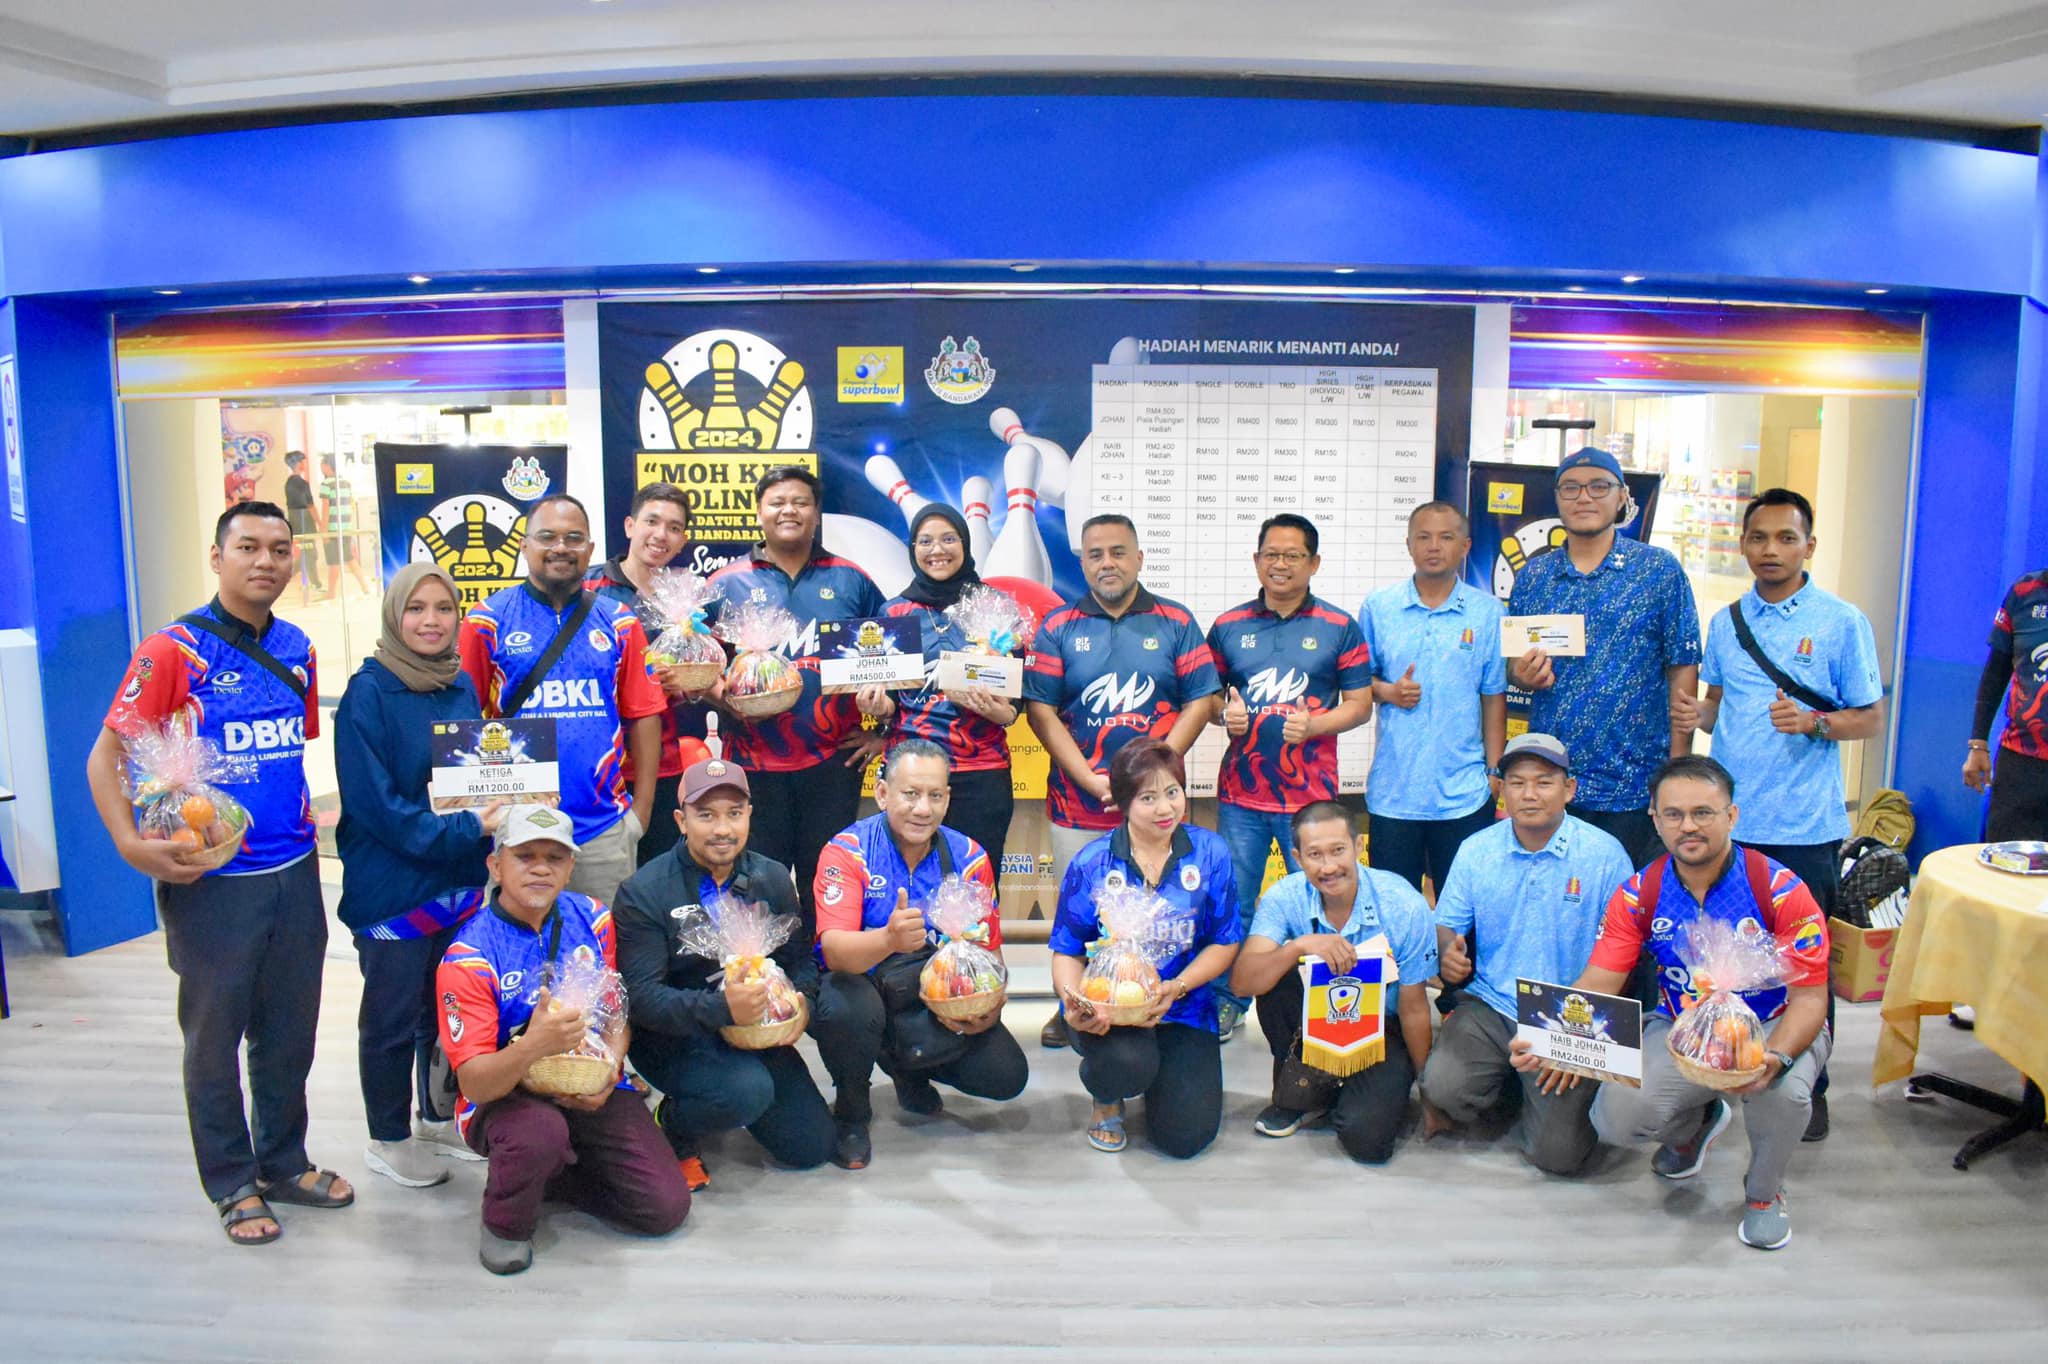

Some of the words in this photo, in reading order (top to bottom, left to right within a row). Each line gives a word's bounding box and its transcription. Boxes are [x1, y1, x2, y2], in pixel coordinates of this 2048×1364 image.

[1139, 339, 1200, 354] HADIAH
[1204, 340, 1274, 354] MENARIK
[1277, 341, 1346, 355] MENANTI
[1349, 343, 1399, 356] ANDA!
[1143, 380, 1179, 388] PASUKAN
[1234, 381, 1264, 389] DOUBLE
[842, 384, 900, 397] superbowl
[1100, 416, 1126, 424] JOHAN
[1196, 417, 1220, 425] RM200
[694, 429, 756, 448] 2024
[1100, 451, 1125, 459] JOHAN
[688, 489, 757, 510] OLIN
[694, 516, 741, 528] DATUK
[454, 564, 499, 577] 2024
[856, 658, 888, 668] JOHAN
[849, 671, 896, 682] RM4500.00
[1088, 716, 1151, 727] MOTIV
[258, 751, 289, 761] LUMPUR
[480, 768, 513, 777] KETIGA
[468, 782, 525, 793] RM1200.00
[1550, 1034, 1572, 1047] NAIB
[1574, 1038, 1606, 1054] JOHAN
[1550, 1048, 1606, 1069] RM2400.00
